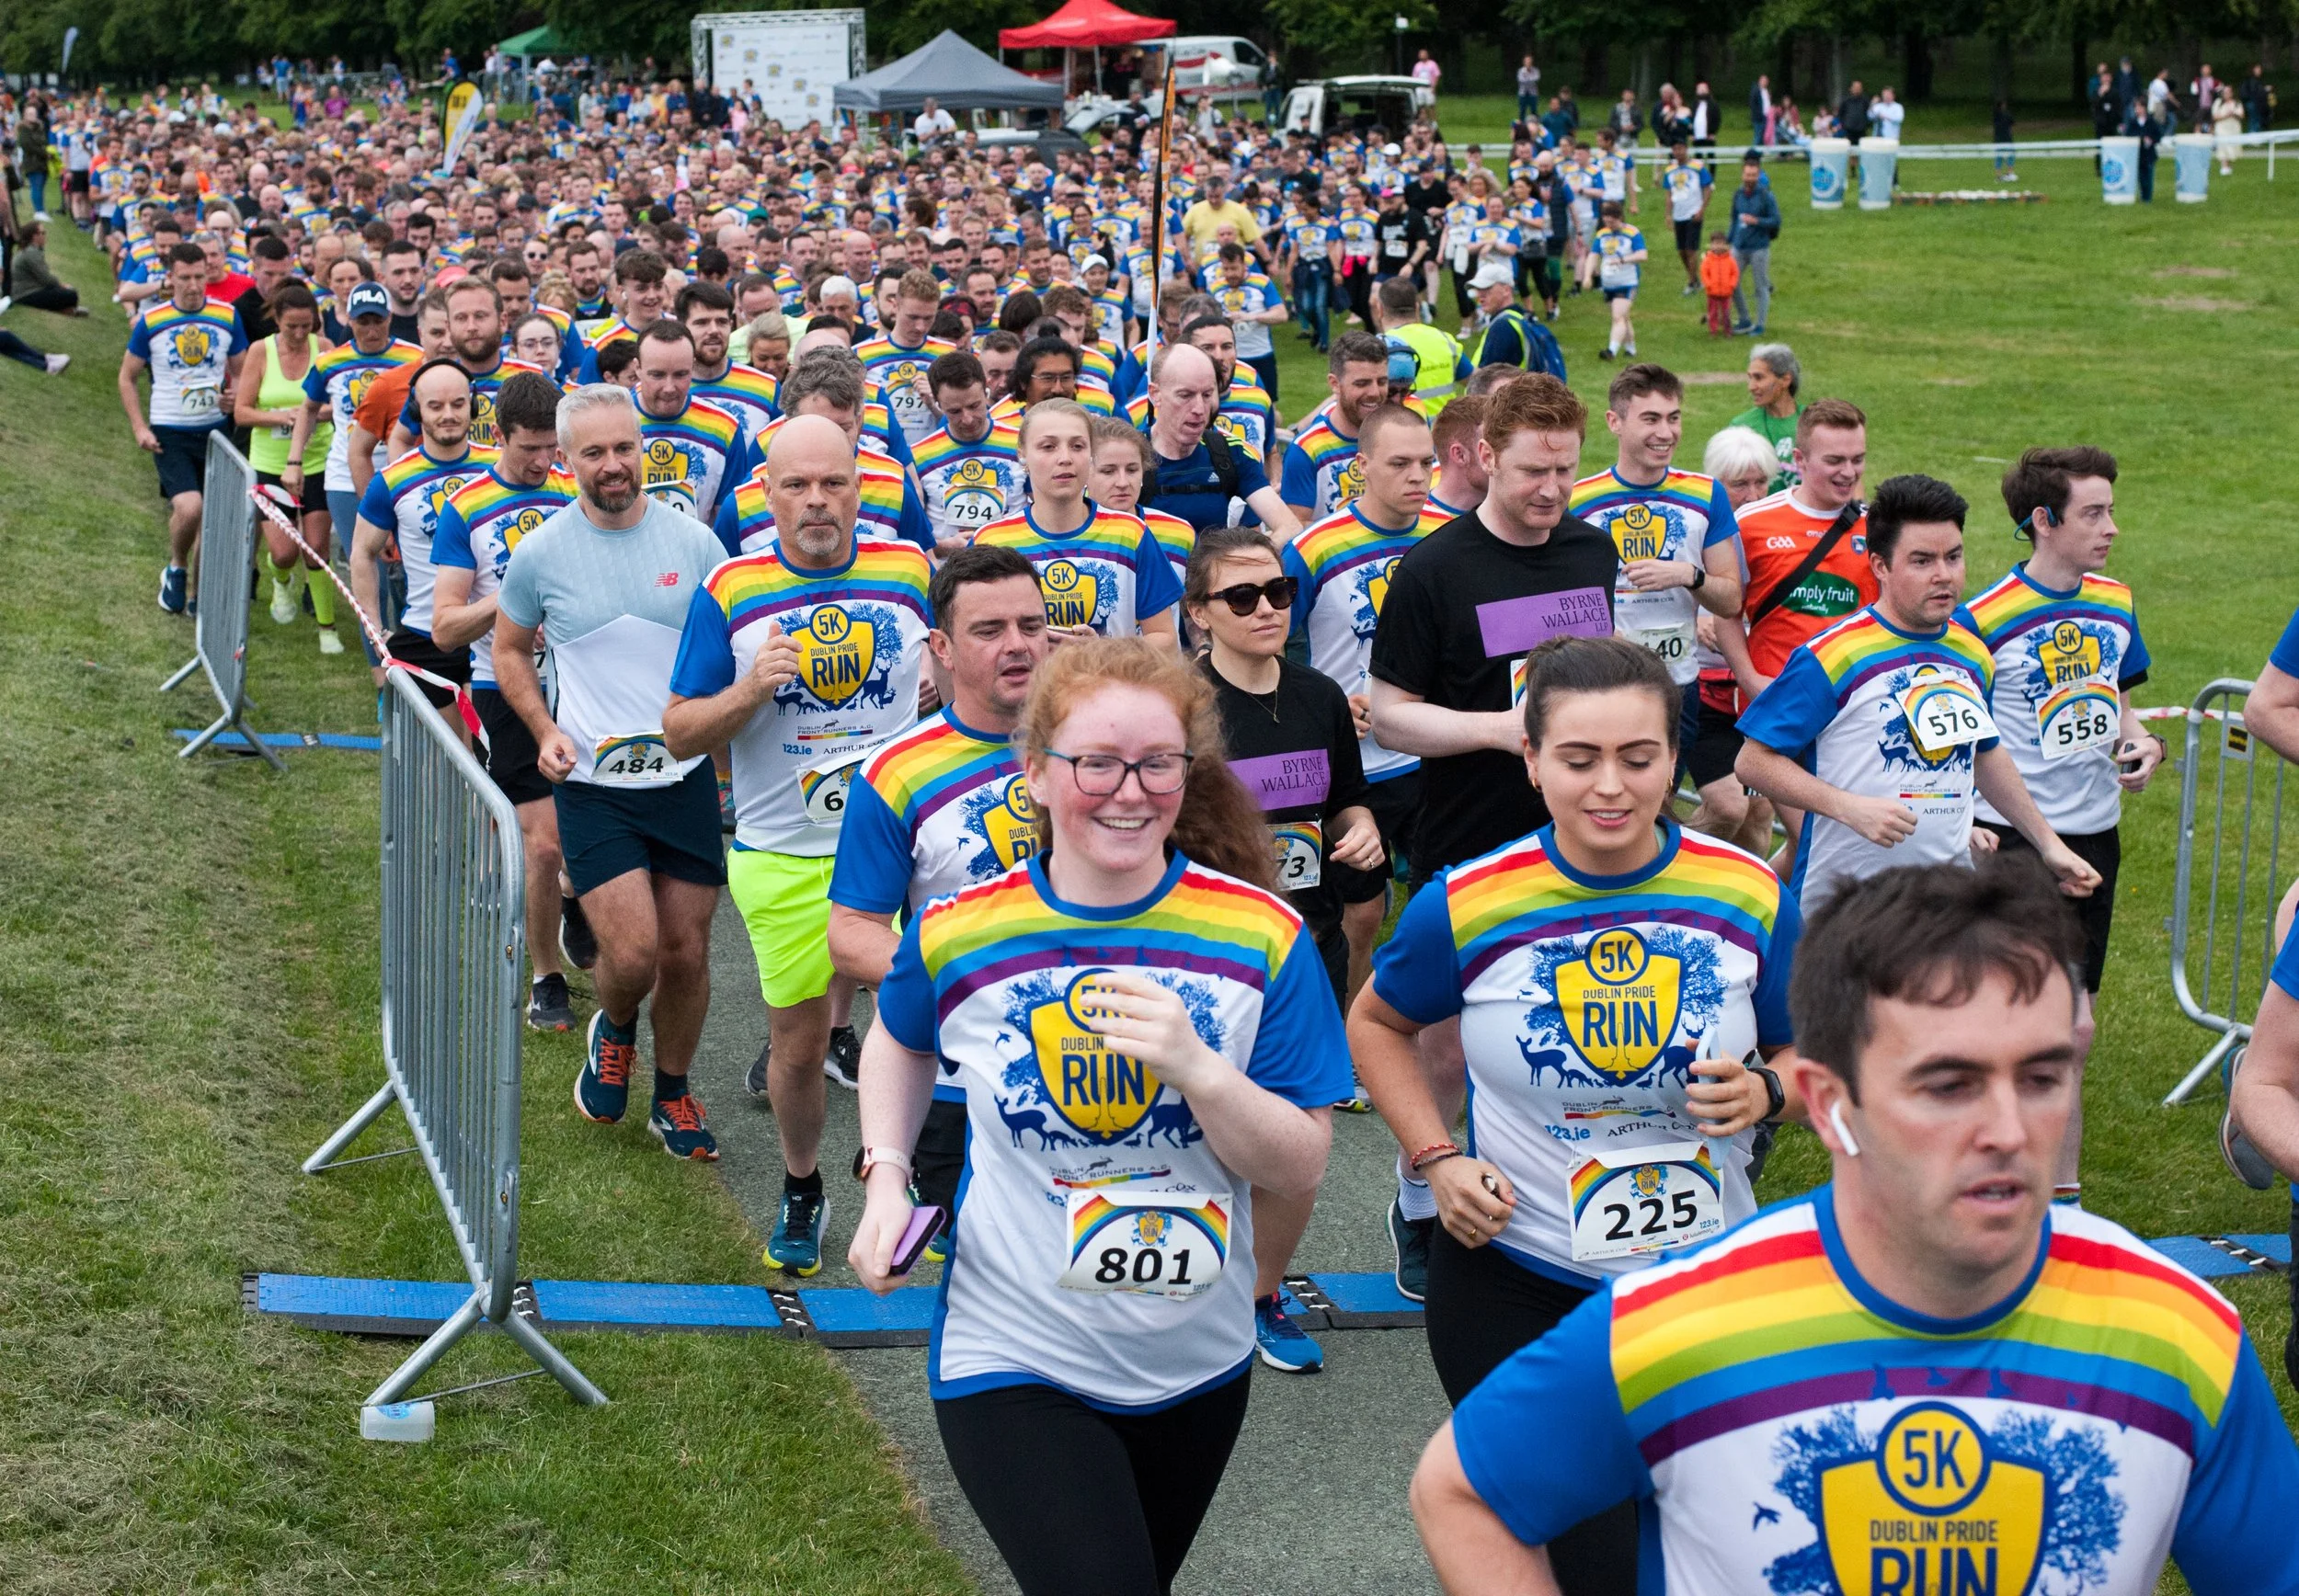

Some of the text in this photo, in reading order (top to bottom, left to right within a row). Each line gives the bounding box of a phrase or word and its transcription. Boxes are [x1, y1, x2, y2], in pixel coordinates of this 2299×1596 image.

[352, 289, 385, 306] FILA
[902, 365, 914, 376] 5K
[189, 396, 214, 409] 743
[895, 396, 924, 408] 797
[654, 444, 669, 460] 5K
[966, 464, 980, 477] 5K
[954, 505, 993, 521] 794
[1630, 507, 1647, 523] 5K
[522, 514, 540, 531] 5K
[1623, 537, 1656, 559] RUN
[1051, 566, 1072, 585] 5K
[1044, 591, 1083, 601] DUBLIN PRIDE
[1559, 593, 1604, 611] BYRNE
[1790, 585, 1854, 603] mply fruit
[1045, 600, 1085, 626] RUN
[1541, 607, 1607, 629] WALLACE
[818, 612, 843, 636] 5K
[1595, 622, 1608, 633] LLP
[2059, 628, 2077, 647] 5K
[810, 643, 858, 656] DUBLIN PRIDE
[811, 652, 861, 689] RUN
[2056, 661, 2091, 684] RUN
[1927, 709, 1978, 736] 576
[2058, 713, 2108, 746] 558
[782, 743, 812, 755] 123.ie
[823, 744, 865, 755] ARTHUR
[608, 757, 664, 774] 484
[1282, 757, 1323, 774] BYRNE
[1262, 771, 1327, 792] WALLACE
[1013, 785, 1030, 813] 5
[1276, 855, 1306, 879] 73
[1599, 940, 1637, 974] 5K
[1583, 986, 1656, 999] DUBLIN PRIDE
[1583, 1000, 1659, 1048] RUN
[1060, 1037, 1104, 1052] DUBLIN
[1061, 1054, 1146, 1107] RUN
[1545, 1123, 1591, 1142] 123.ie
[1089, 1167, 1144, 1179] RUNNERS
[1641, 1180, 1656, 1190] RUN
[1603, 1190, 1698, 1241] 225
[1699, 1218, 1719, 1229] 123.ie
[1143, 1226, 1159, 1238] RUN
[1094, 1247, 1192, 1285] 801
[1903, 1429, 1966, 1489] 5K
[1870, 1519, 1998, 1543] DUBLIN PRIDE
[1870, 1547, 1998, 1596] RUN
